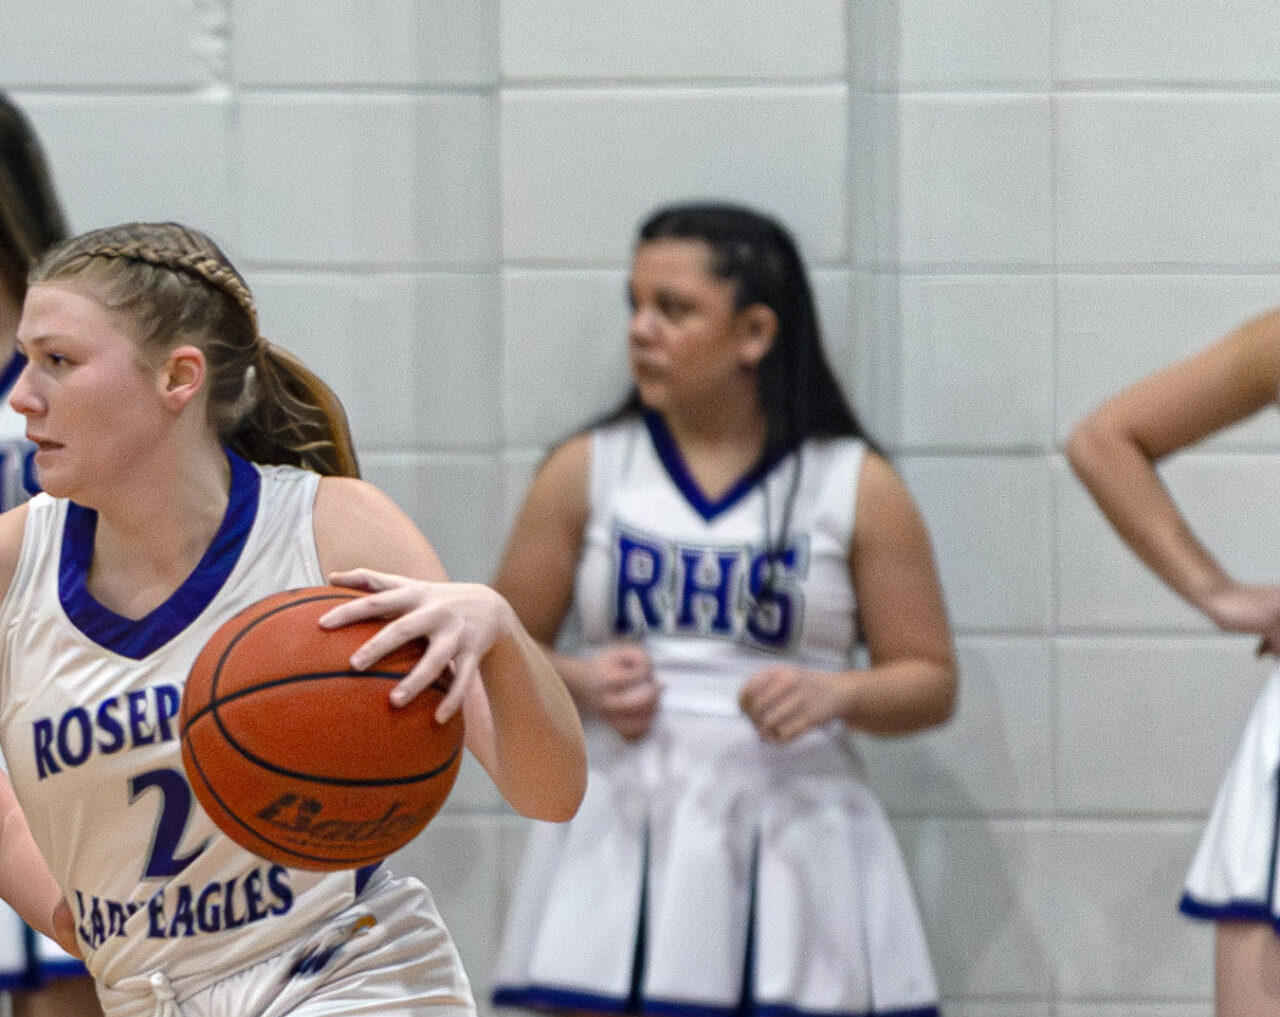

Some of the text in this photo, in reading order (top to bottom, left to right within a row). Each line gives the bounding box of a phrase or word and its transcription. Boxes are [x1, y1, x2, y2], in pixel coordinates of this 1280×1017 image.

[614, 534, 802, 650] RHS
[32, 684, 183, 781] ROSEP
[127, 768, 211, 882] 2
[147, 864, 294, 938] EAGLES
